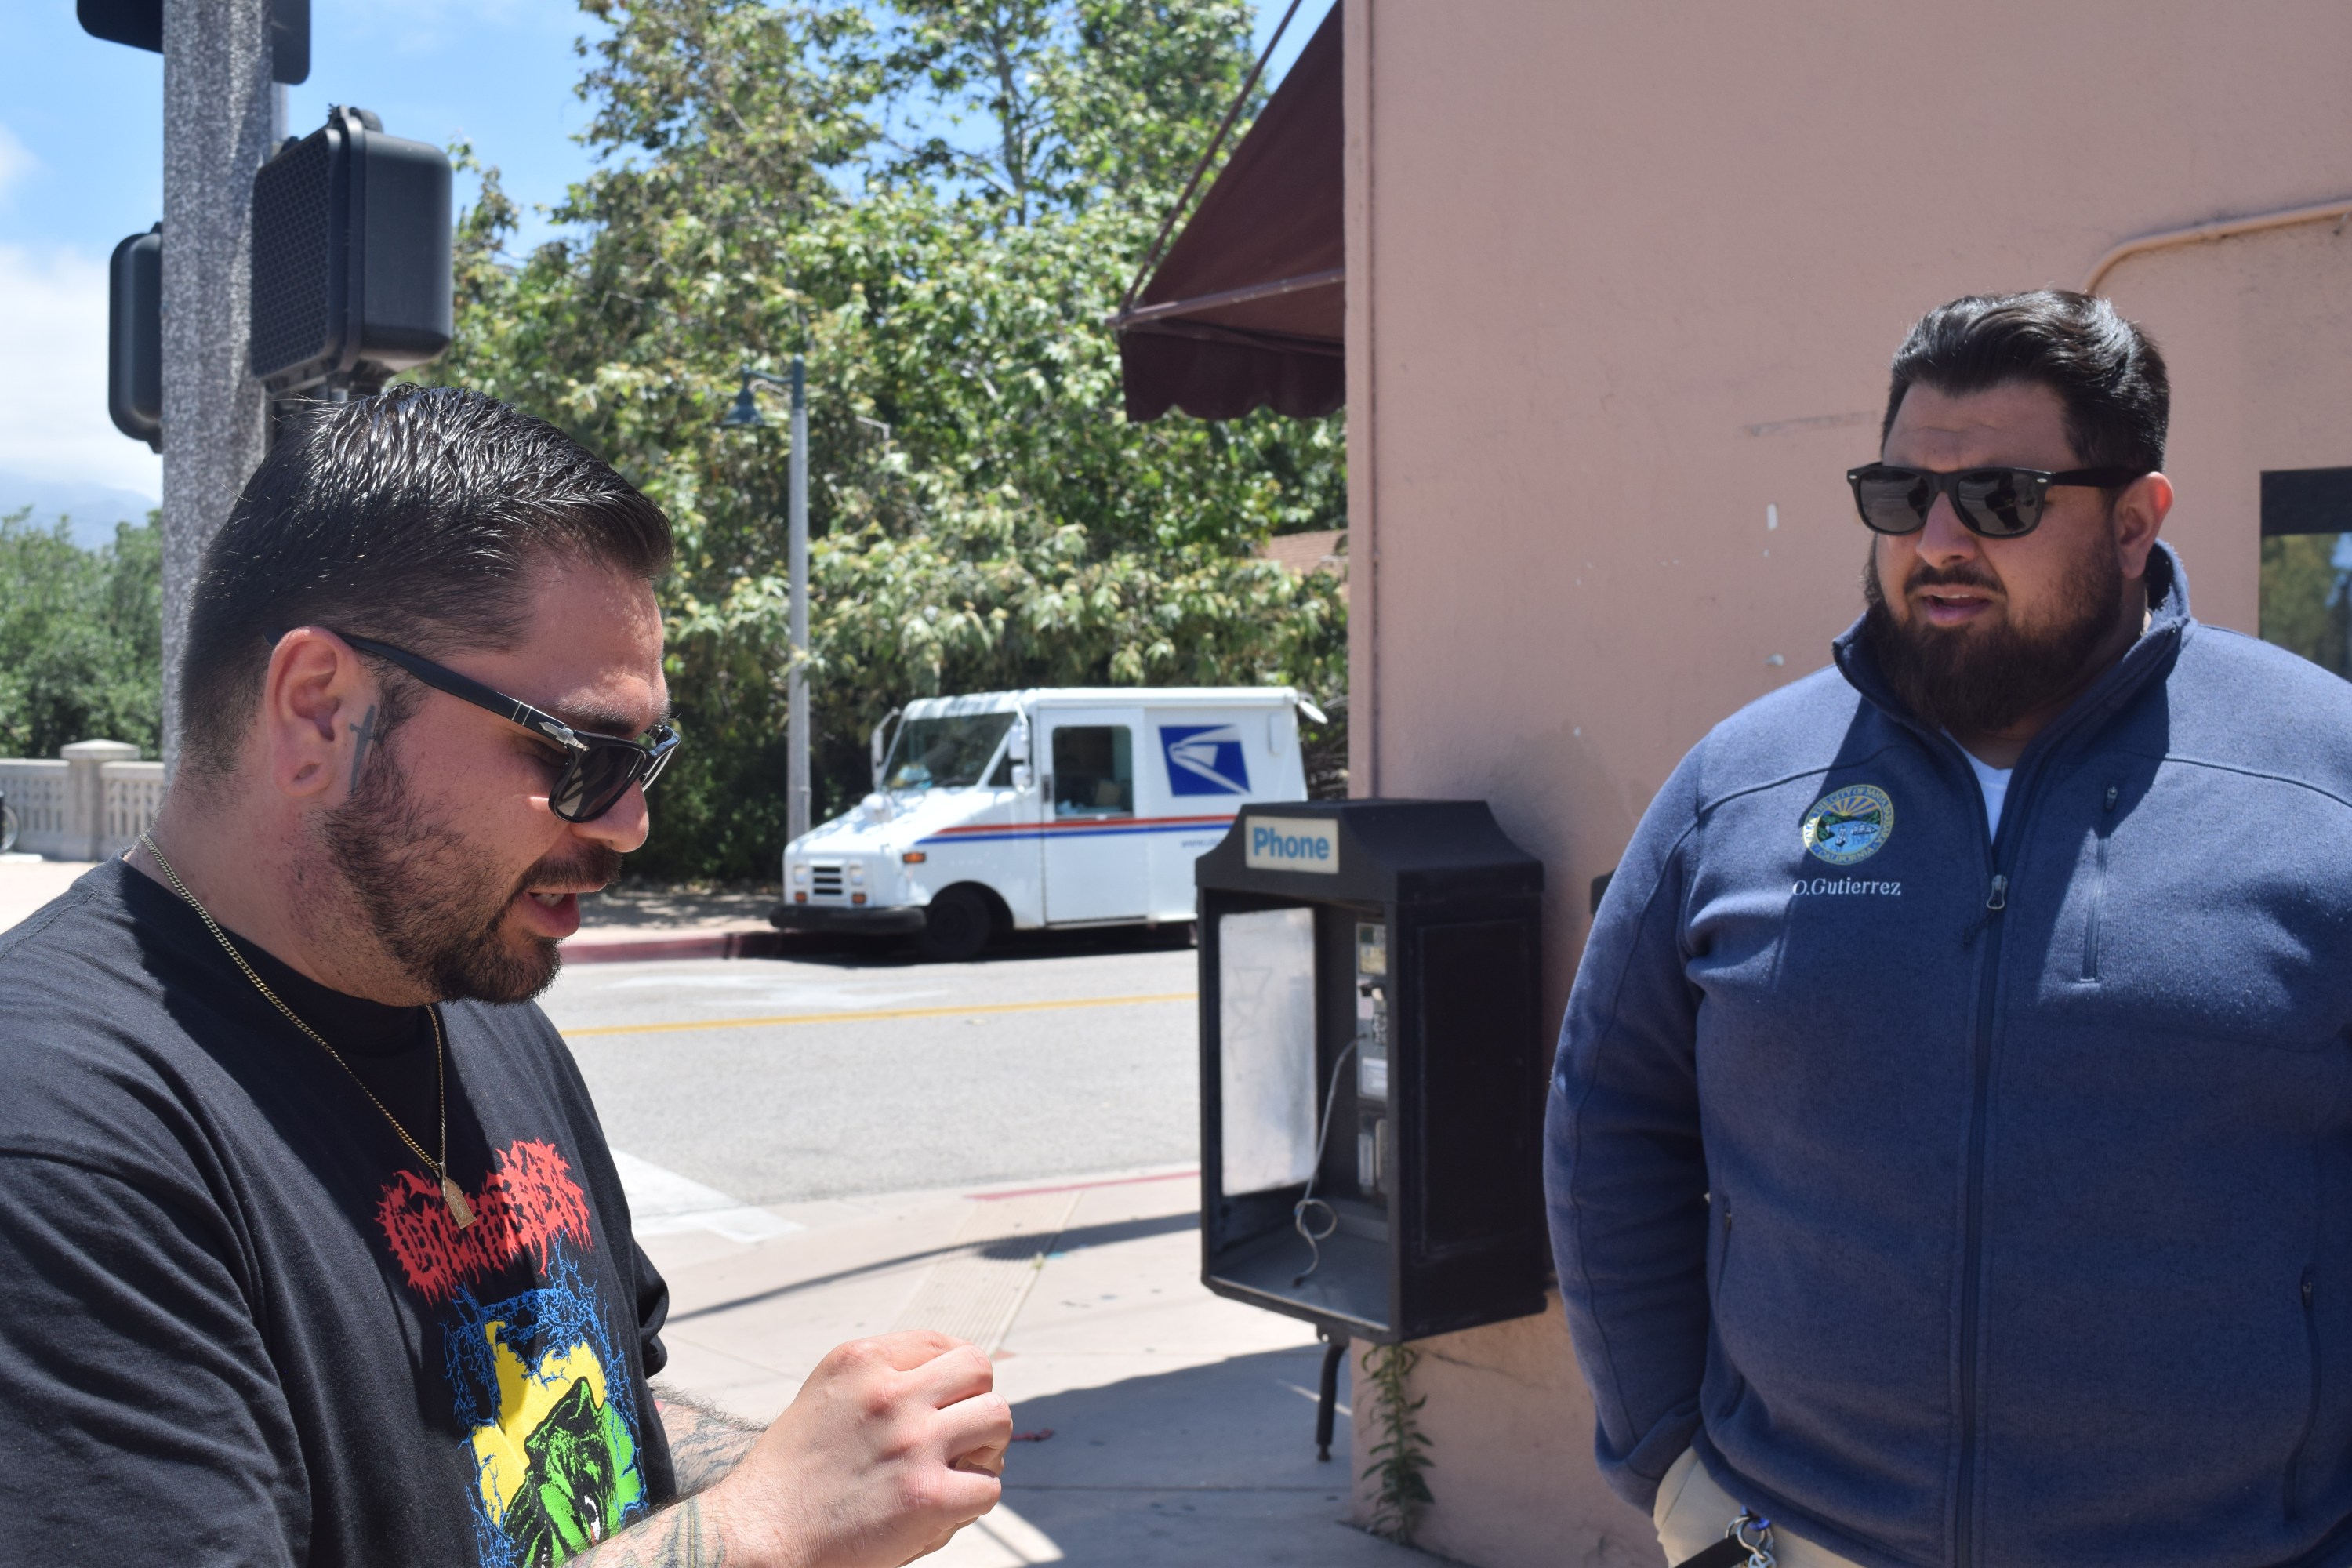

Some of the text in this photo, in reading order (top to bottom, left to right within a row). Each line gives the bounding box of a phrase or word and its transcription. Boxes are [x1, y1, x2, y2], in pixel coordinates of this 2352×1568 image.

[1828, 788, 1852, 802] CITY
[1852, 787, 1866, 796] OF
[1253, 826, 1330, 860] Phone
[1817, 846, 1874, 862] CALIFORNIA
[1792, 877, 1901, 895] O.Gutierrez
